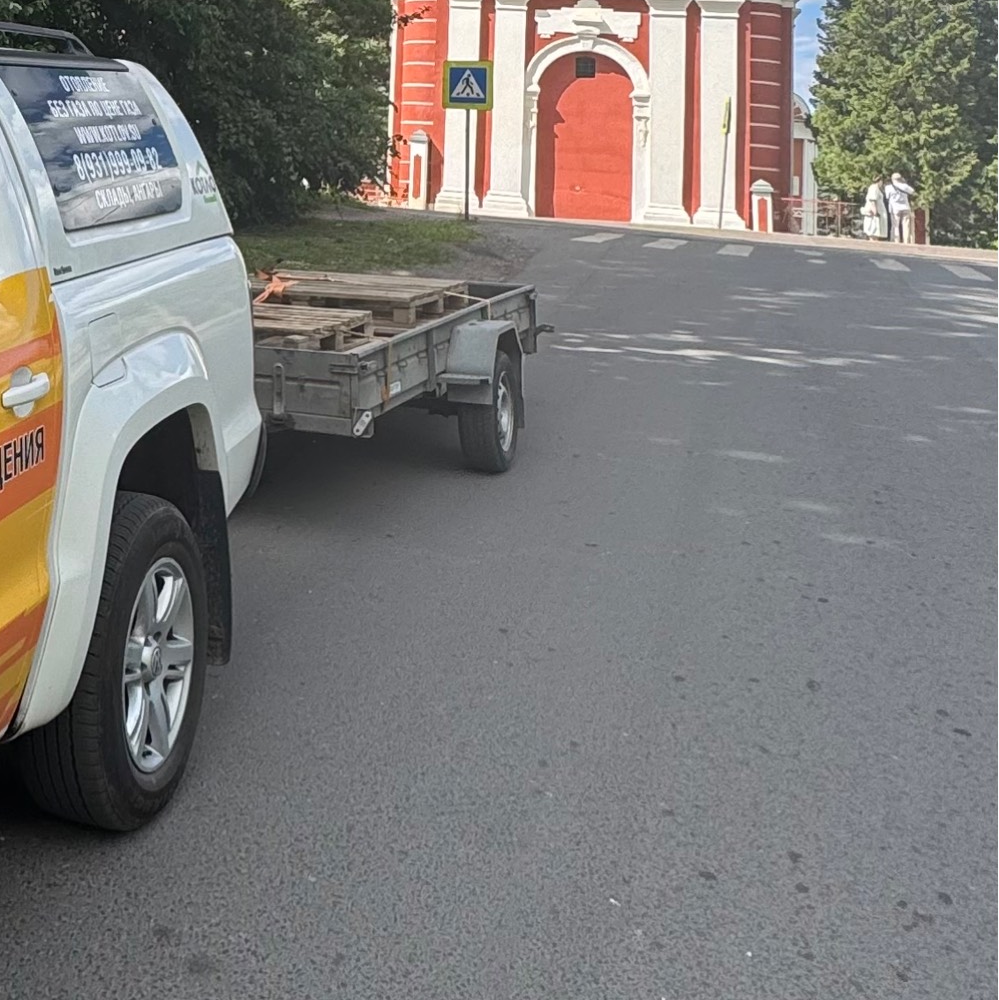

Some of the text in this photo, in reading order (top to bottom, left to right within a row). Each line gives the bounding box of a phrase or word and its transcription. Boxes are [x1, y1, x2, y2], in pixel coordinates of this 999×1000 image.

[47, 100, 70, 117] БЕЗ
[65, 100, 92, 117] ГАЗА
[87, 101, 104, 116] ПО
[118, 100, 142, 116] ГАЗА
[73, 124, 142, 143] WWW.KOTLOV.SU
[73, 147, 163, 183] 8(931)999-09-82
[132, 181, 165, 201] АНГАРЫ
